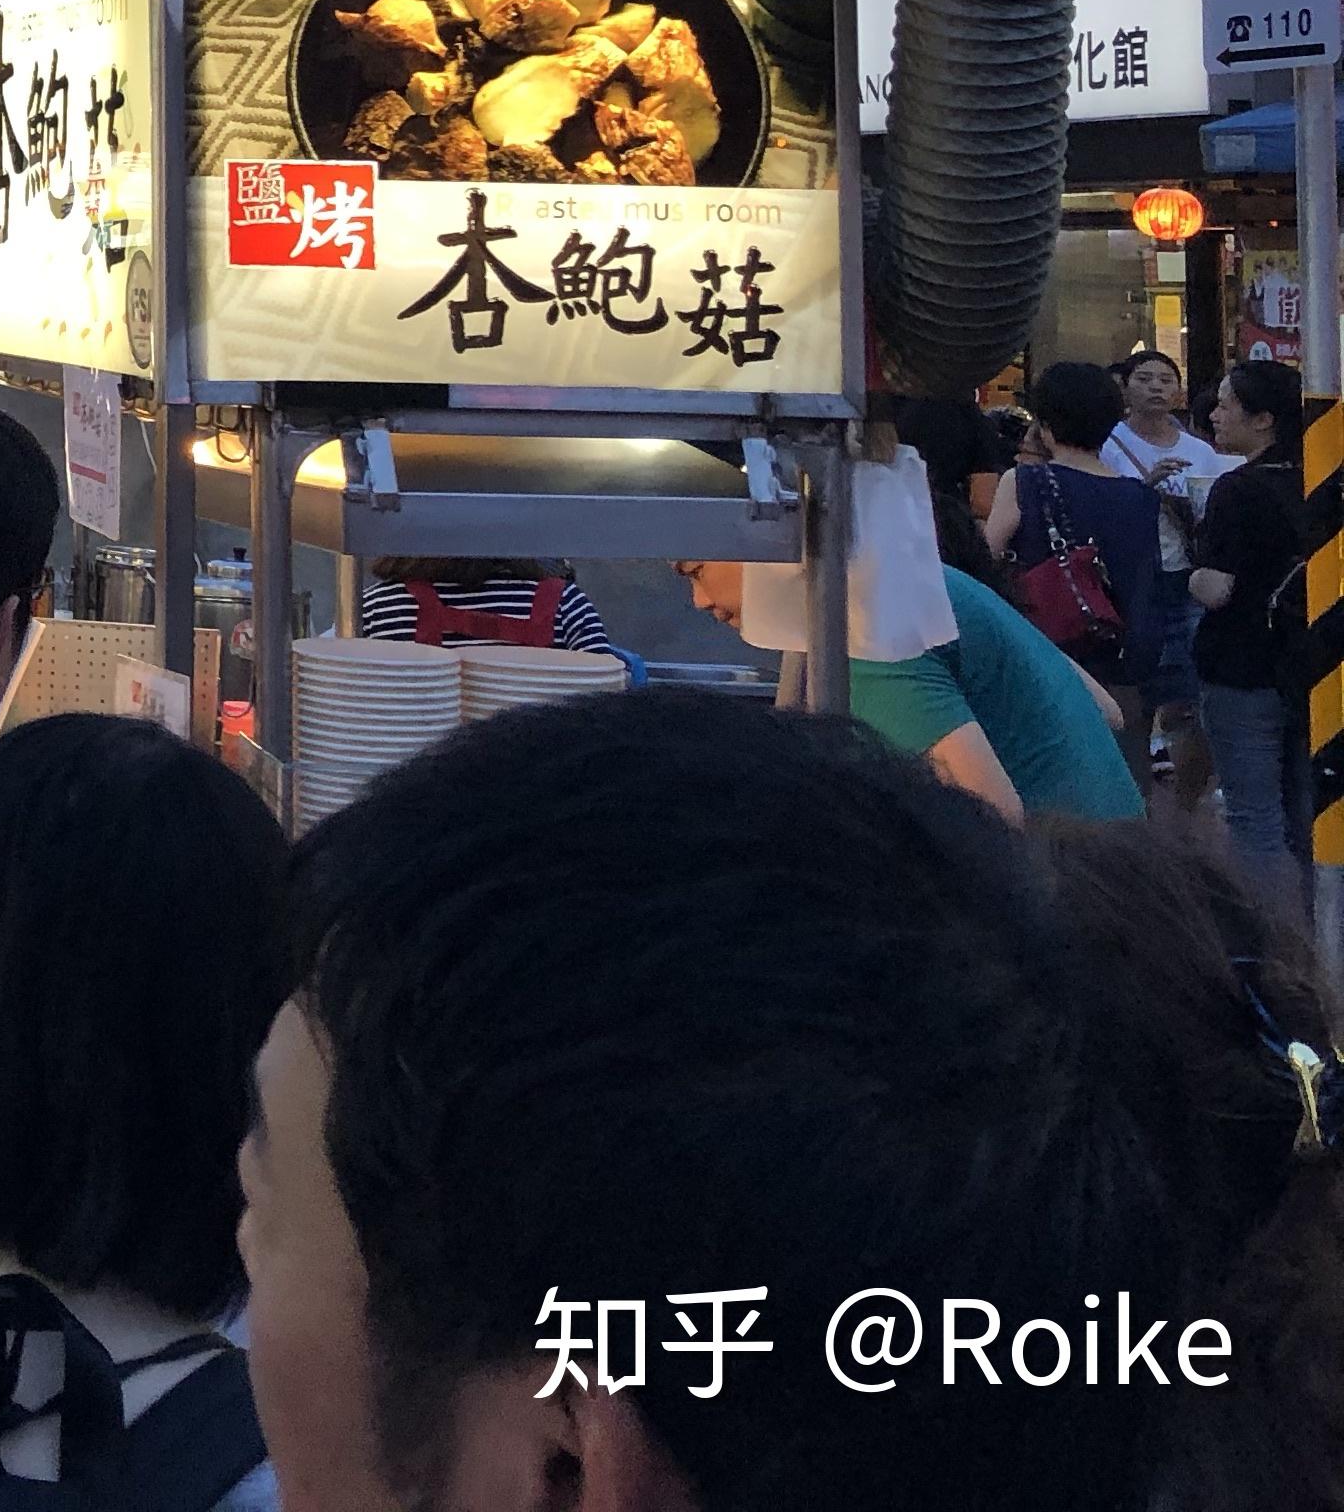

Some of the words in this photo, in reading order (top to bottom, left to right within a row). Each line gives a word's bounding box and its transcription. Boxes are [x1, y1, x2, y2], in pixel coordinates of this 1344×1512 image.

[1263, 8, 1312, 39] 110
[235, 162, 375, 270] 鹽烤
[624, 196, 783, 225] musroom
[397, 188, 784, 367] 杏鮑菇
